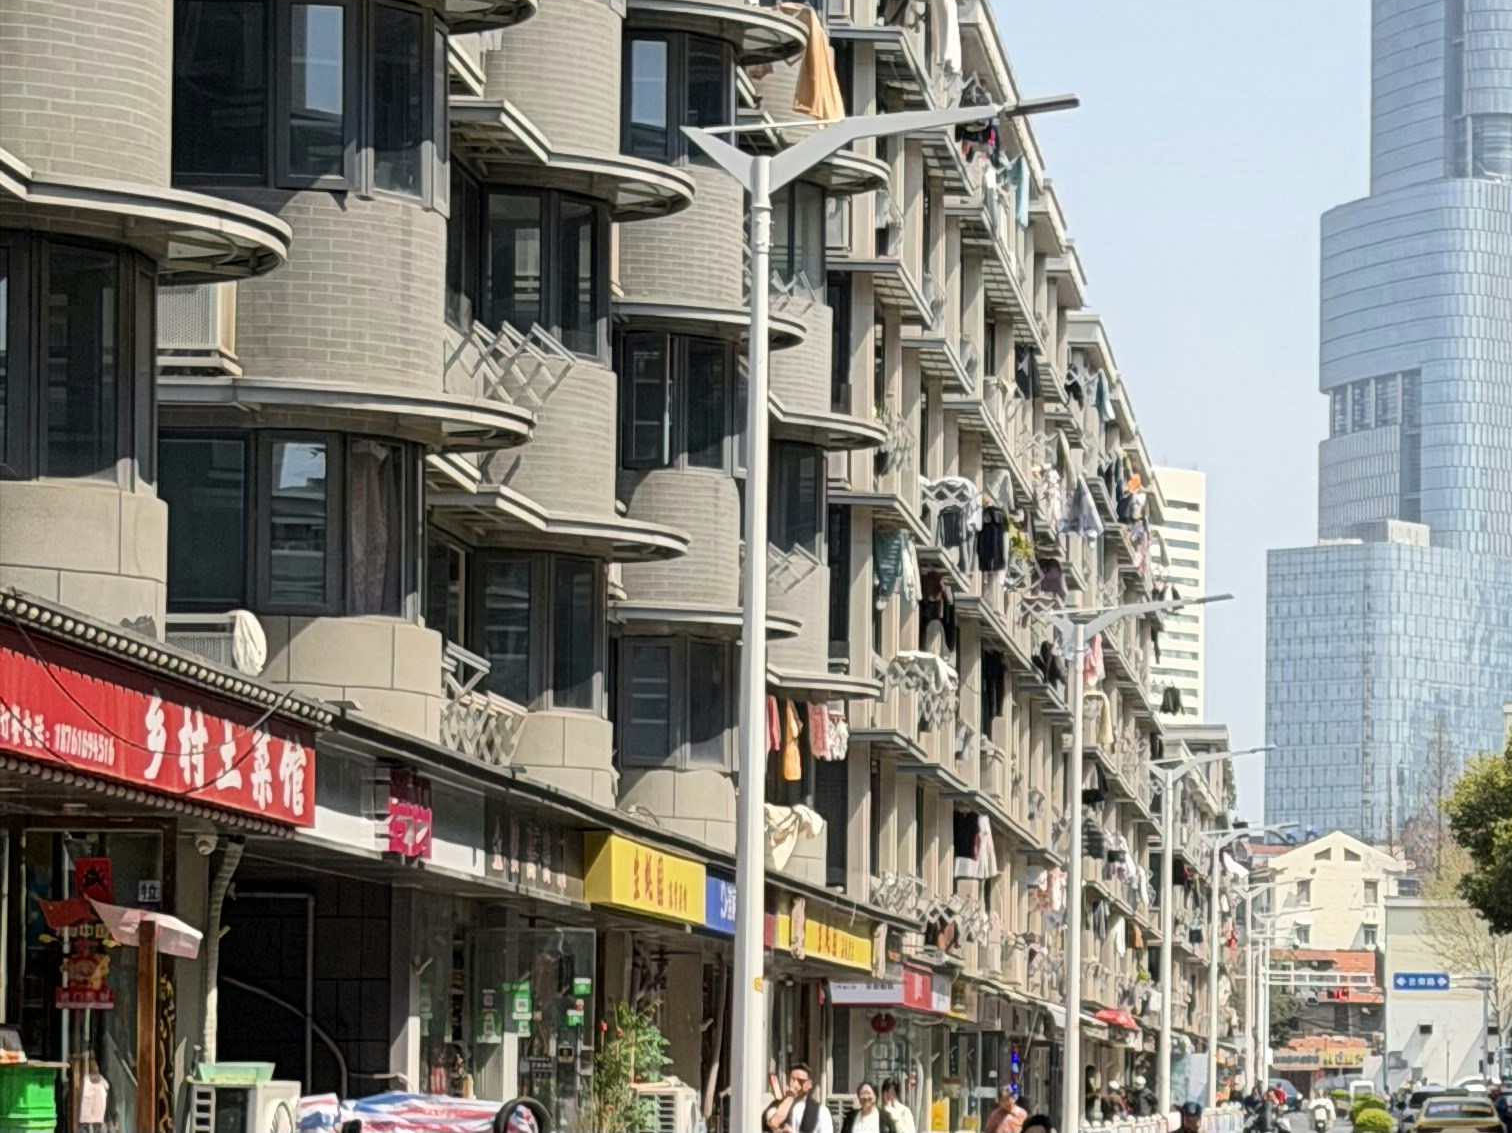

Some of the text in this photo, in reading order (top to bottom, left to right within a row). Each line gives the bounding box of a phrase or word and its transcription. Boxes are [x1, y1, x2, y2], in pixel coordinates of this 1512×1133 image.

[144, 691, 307, 816] 乡村土菜馆
